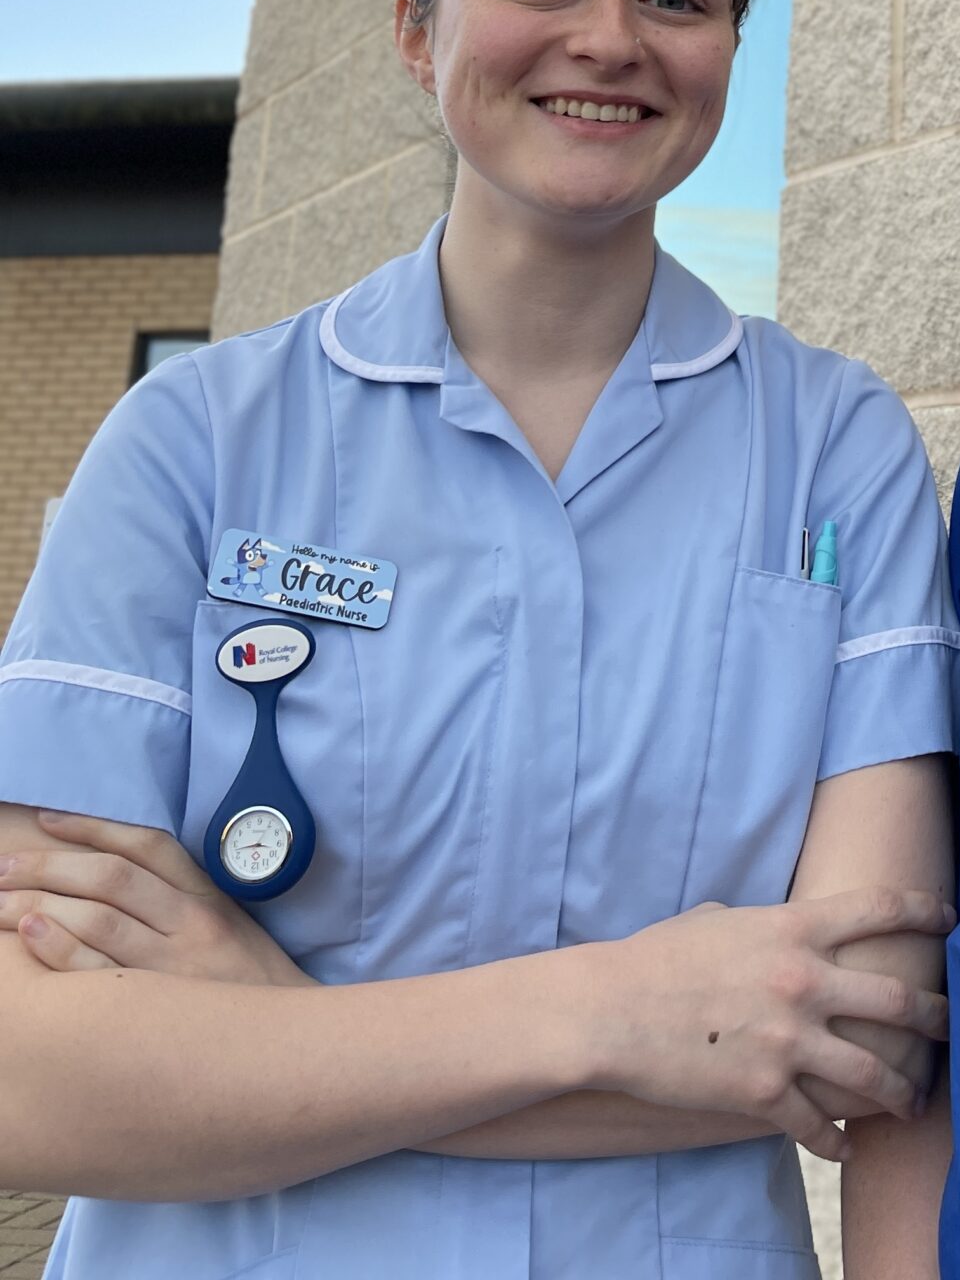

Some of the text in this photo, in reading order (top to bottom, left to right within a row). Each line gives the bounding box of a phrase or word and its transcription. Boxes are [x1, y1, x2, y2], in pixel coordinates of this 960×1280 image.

[291, 544, 380, 574] Hello my name is
[280, 558, 378, 604] Grace
[278, 594, 368, 622] Paediatric Nurse
[258, 646, 298, 656] Royal College
[266, 654, 290, 662] Nursing
